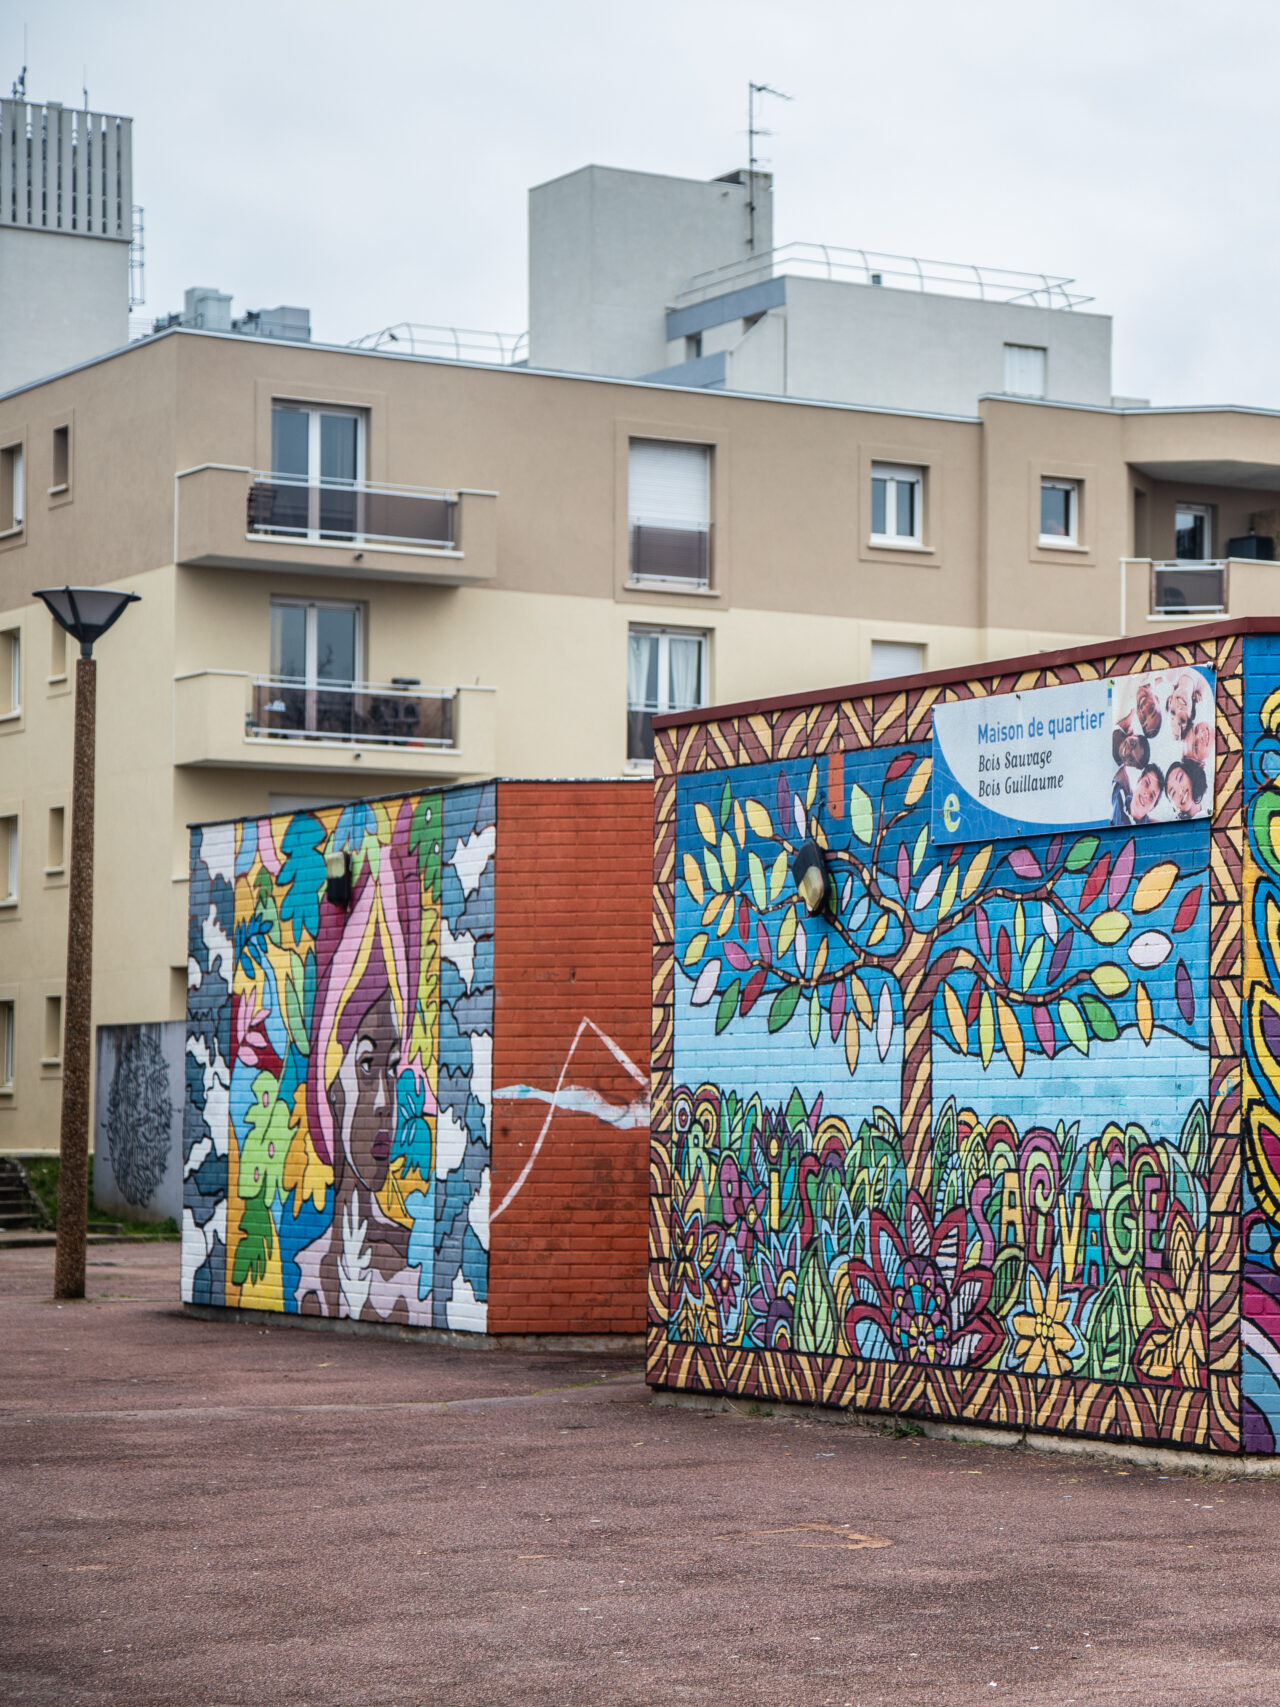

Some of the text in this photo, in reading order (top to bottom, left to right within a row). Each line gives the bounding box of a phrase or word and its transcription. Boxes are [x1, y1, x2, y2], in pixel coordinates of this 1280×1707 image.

[977, 708, 1105, 744] Maison de quartier
[978, 750, 1053, 772] Bois Sauvage
[978, 774, 1064, 797] Bois Guillaume
[969, 1168, 1165, 1287] SAUVAGE
